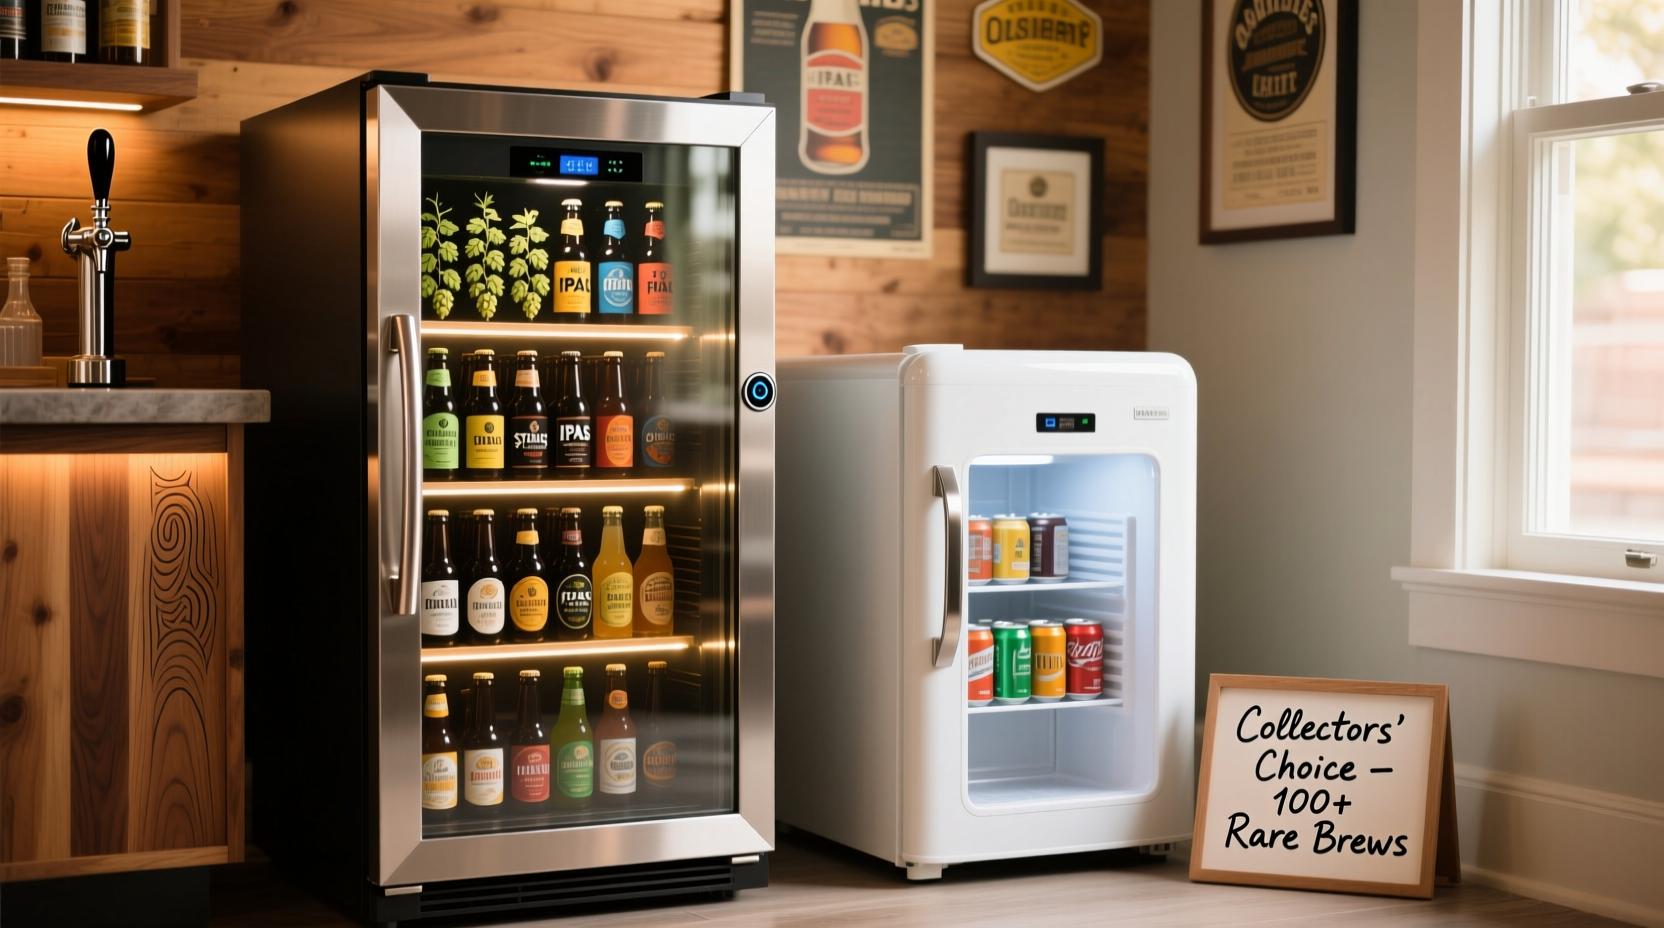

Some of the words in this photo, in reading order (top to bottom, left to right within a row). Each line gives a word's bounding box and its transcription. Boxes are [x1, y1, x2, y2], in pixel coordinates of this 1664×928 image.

[1237, 705, 1405, 744] Collectors'
[1255, 749, 1357, 782] Choice
[1273, 786, 1352, 816] 100+
[1225, 812, 1299, 850] Rare
[1313, 820, 1408, 857] Brews
